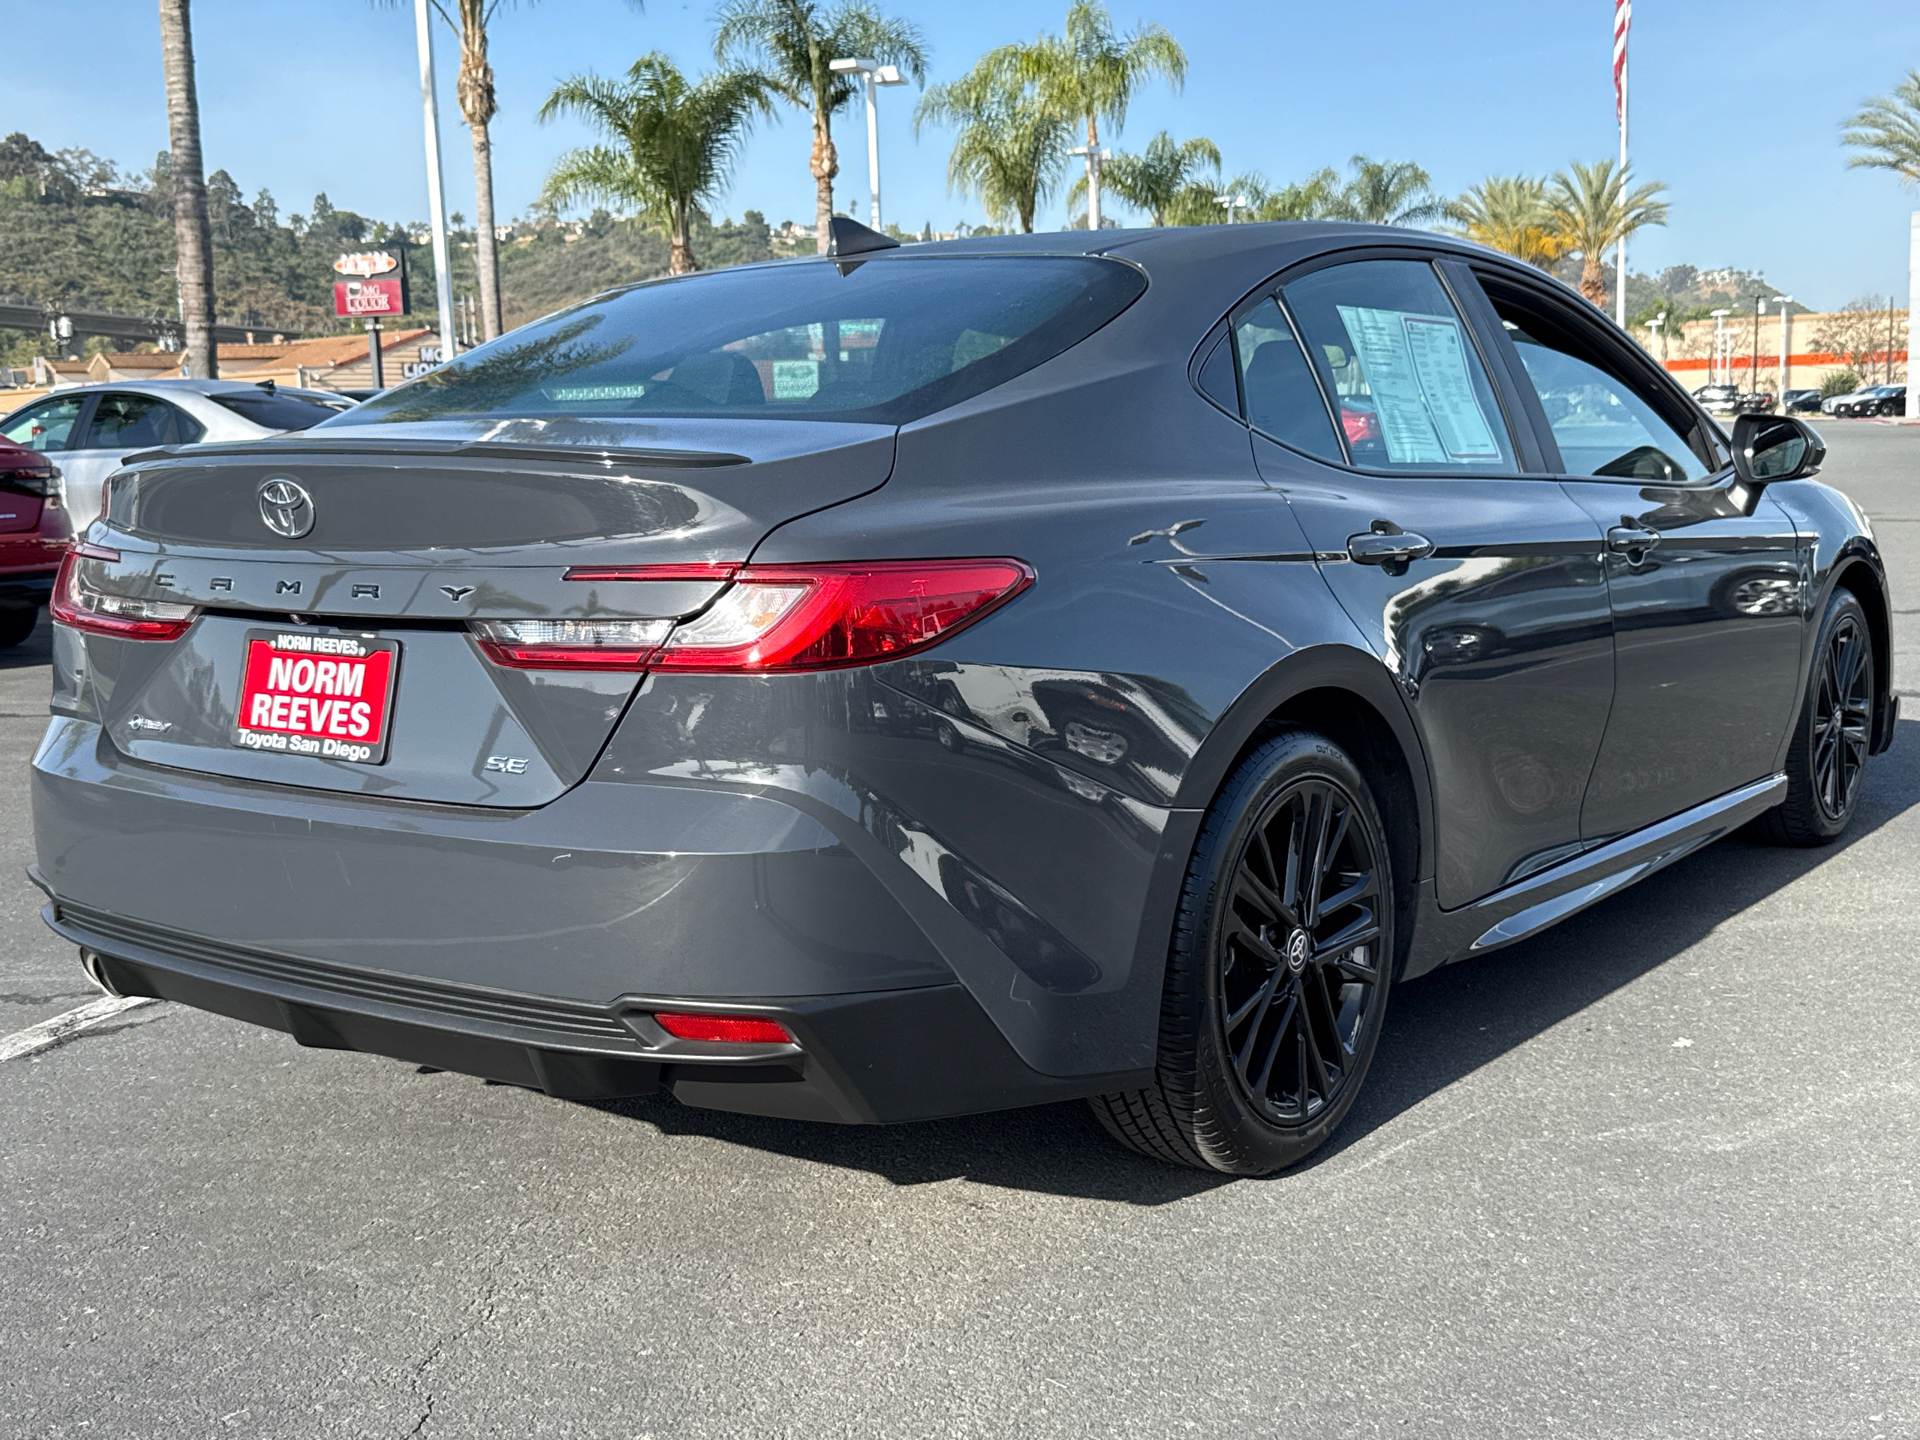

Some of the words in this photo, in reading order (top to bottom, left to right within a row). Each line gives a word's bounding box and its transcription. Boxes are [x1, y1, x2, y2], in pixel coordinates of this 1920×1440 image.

[154, 573, 477, 602] CAMRY
[277, 634, 312, 651] NORM
[313, 637, 359, 655] REEVES
[267, 657, 366, 698] NORM
[250, 692, 372, 738] REEVES
[238, 728, 287, 749] Toyota
[289, 735, 320, 753] San
[322, 738, 371, 761] Diego
[484, 756, 530, 775] SE
